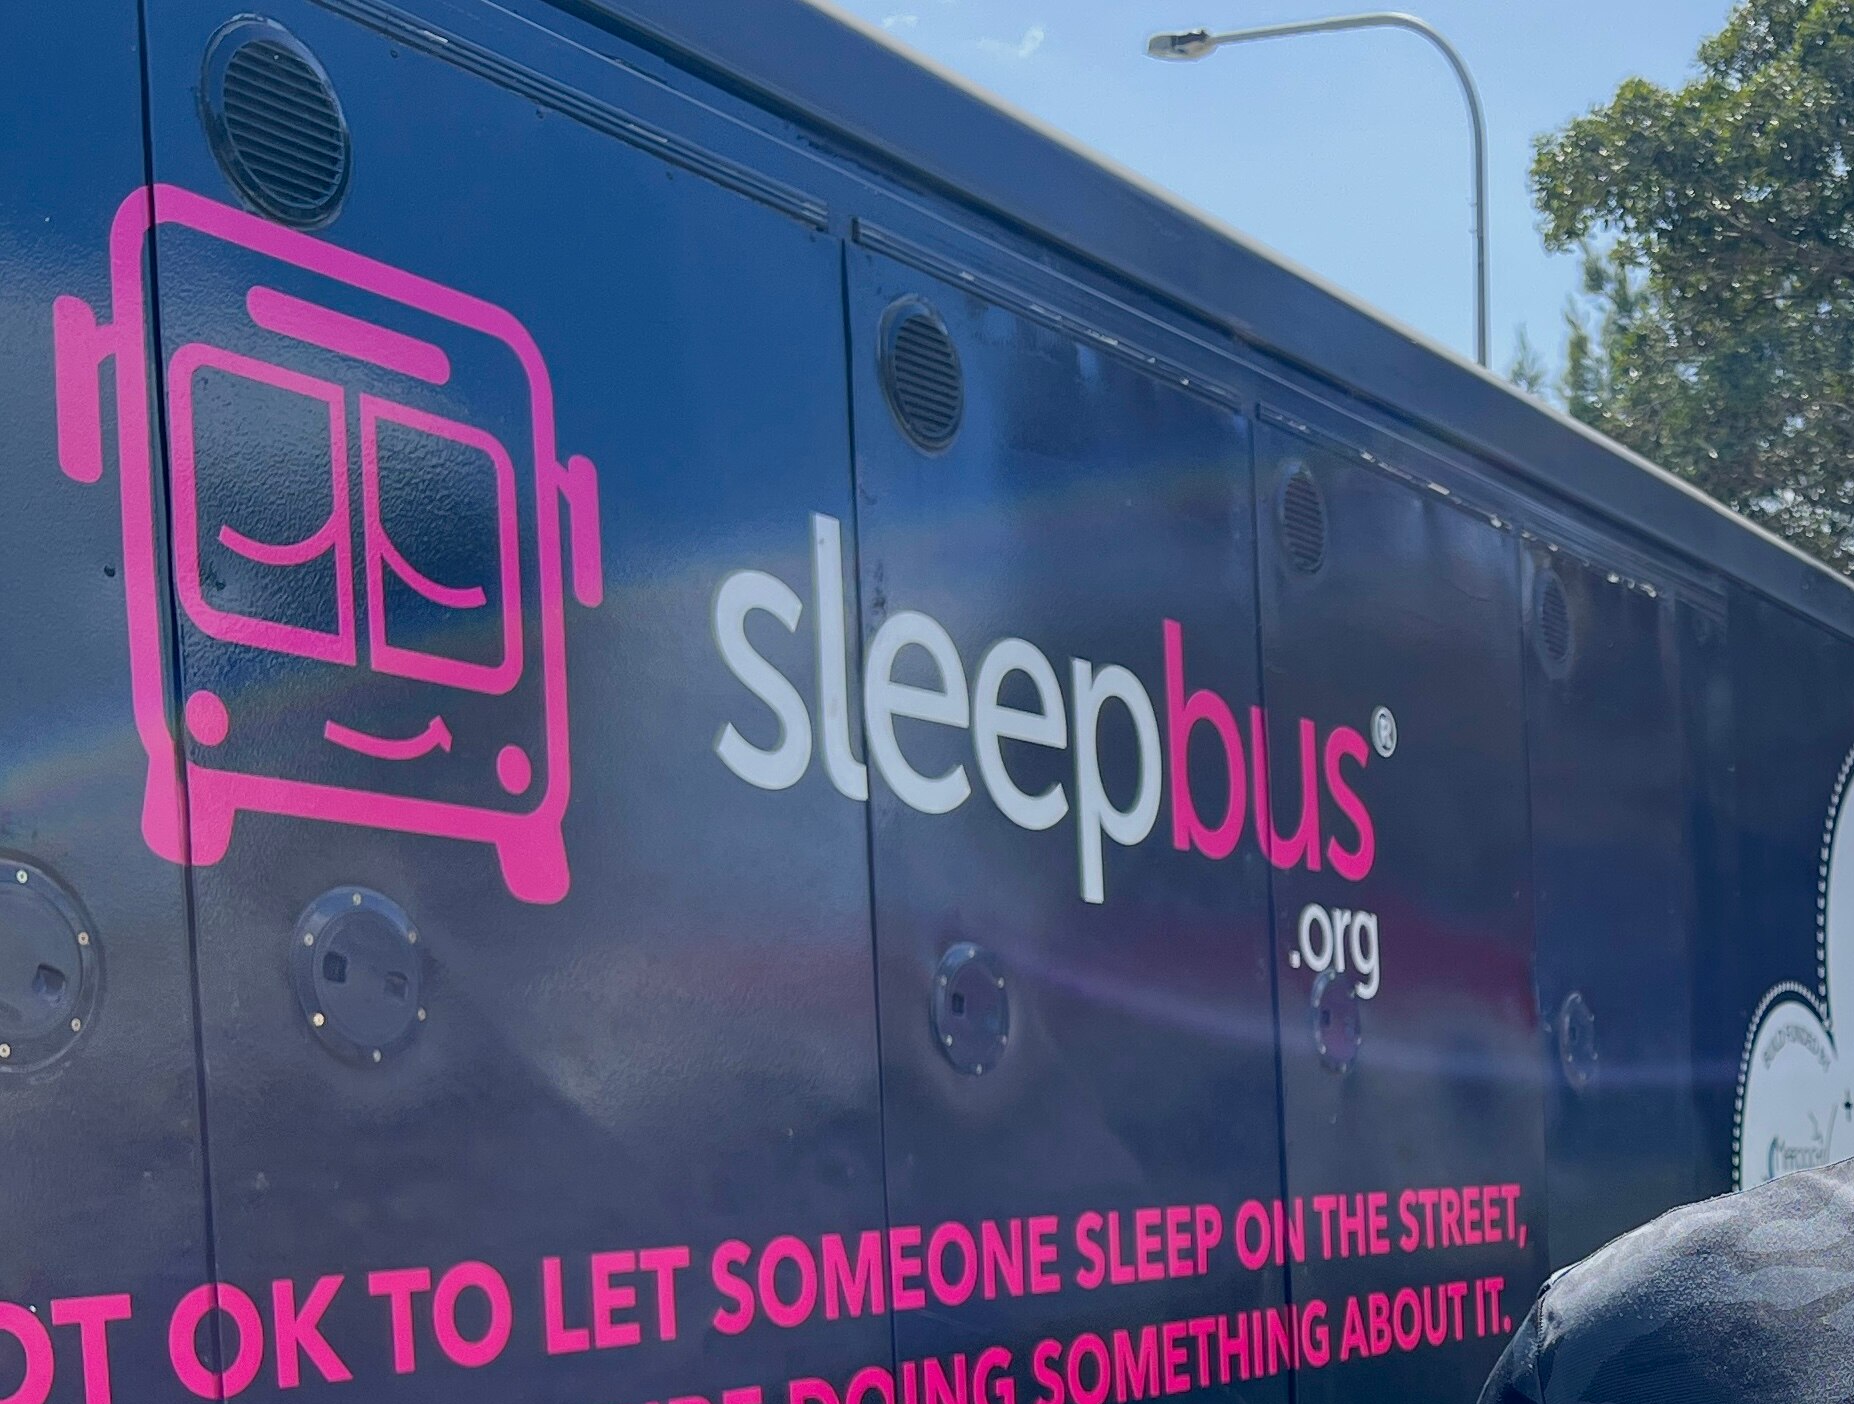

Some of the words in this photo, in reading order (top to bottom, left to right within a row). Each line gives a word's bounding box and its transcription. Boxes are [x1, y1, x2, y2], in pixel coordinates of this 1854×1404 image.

[1288, 903, 1380, 1000] .org
[168, 1275, 353, 1400] OK
[367, 1260, 513, 1374] TO
[542, 1246, 691, 1356] LET
[711, 1215, 1062, 1335] SOMEONE
[1075, 1204, 1224, 1289] SLEEP
[1234, 1197, 1306, 1271] ON
[1313, 1191, 1392, 1259] THE
[1399, 1183, 1529, 1252] STREET,
[1340, 1281, 1468, 1362] ABOUT
[1475, 1275, 1513, 1337] IT.
